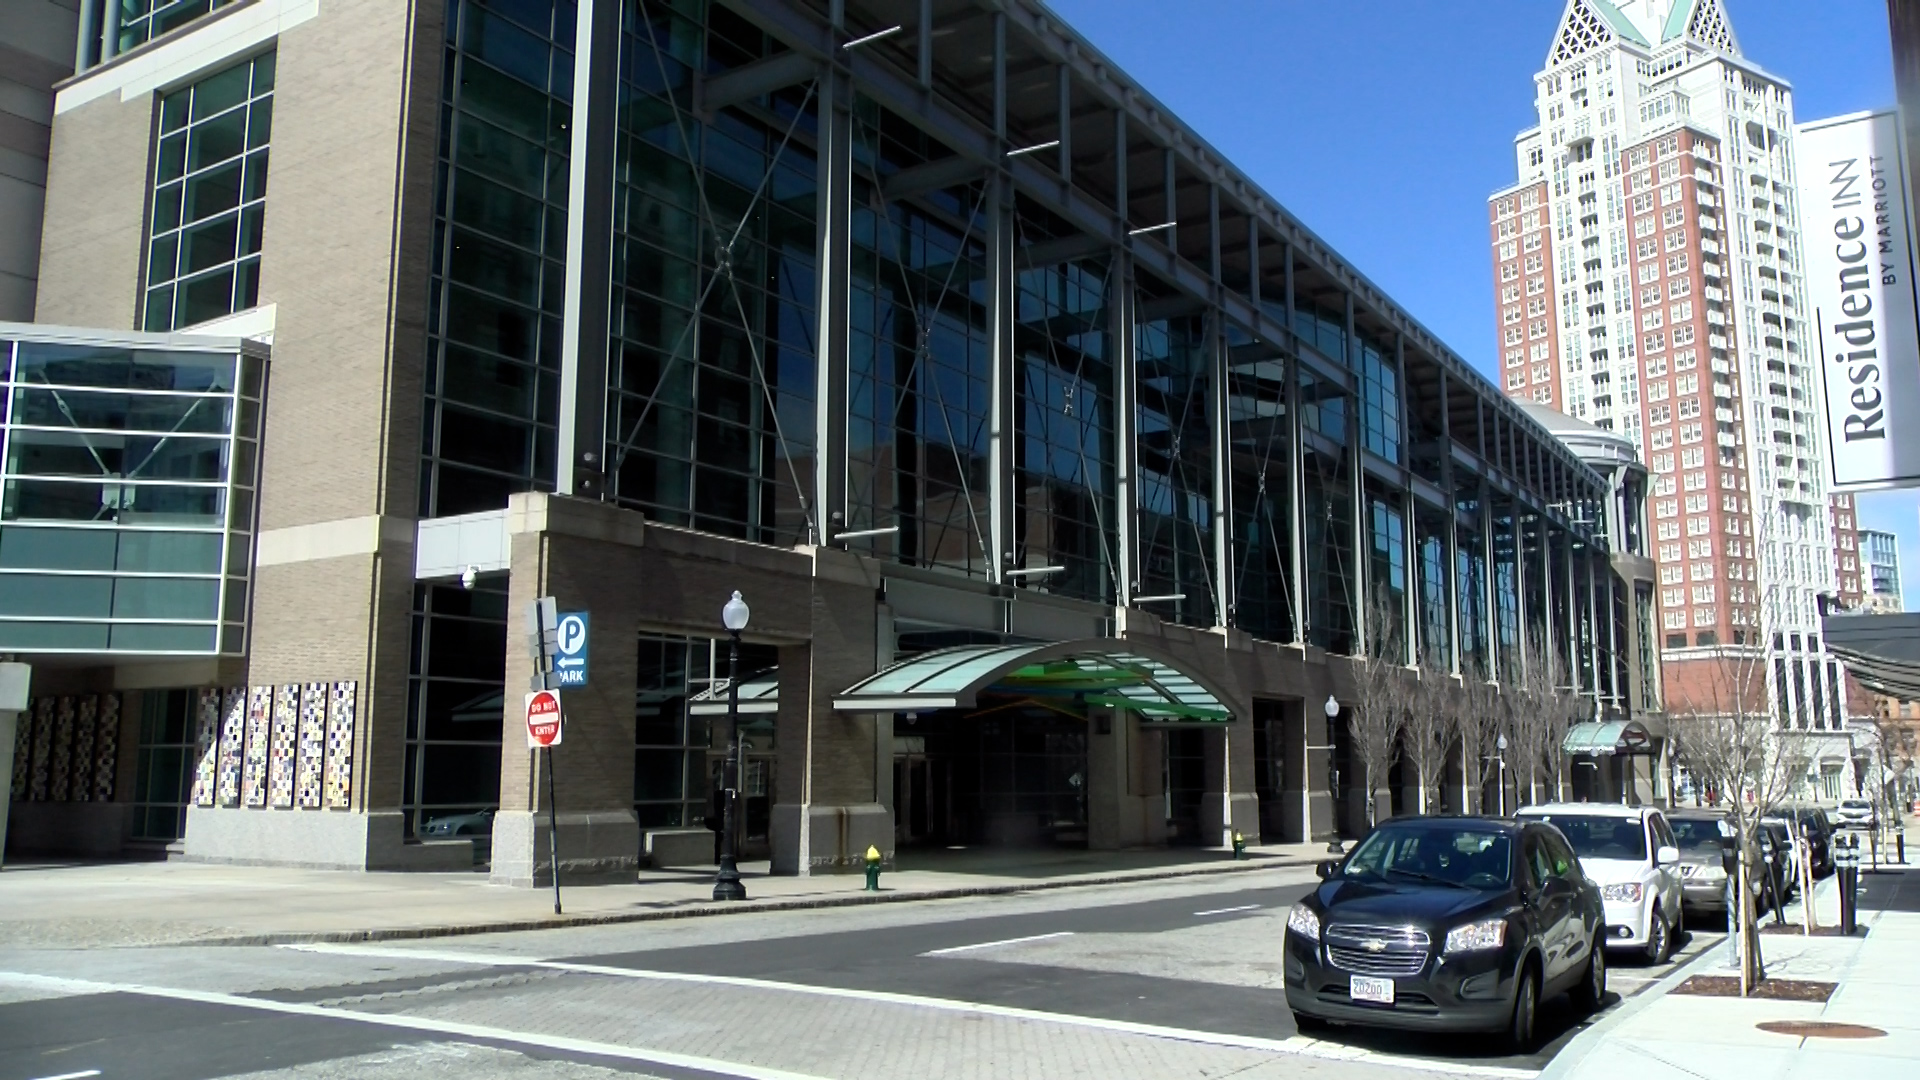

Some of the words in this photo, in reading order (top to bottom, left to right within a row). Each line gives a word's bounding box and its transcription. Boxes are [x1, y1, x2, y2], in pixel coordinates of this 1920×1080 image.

[1828, 158, 1862, 209] INN
[1869, 154, 1892, 254] MARRIOTT
[1882, 264, 1897, 287] BY
[1834, 216, 1885, 443] Residence
[564, 620, 581, 650] P
[531, 703, 541, 713] DO
[543, 700, 556, 711] NOT
[535, 724, 555, 735] ENTER
